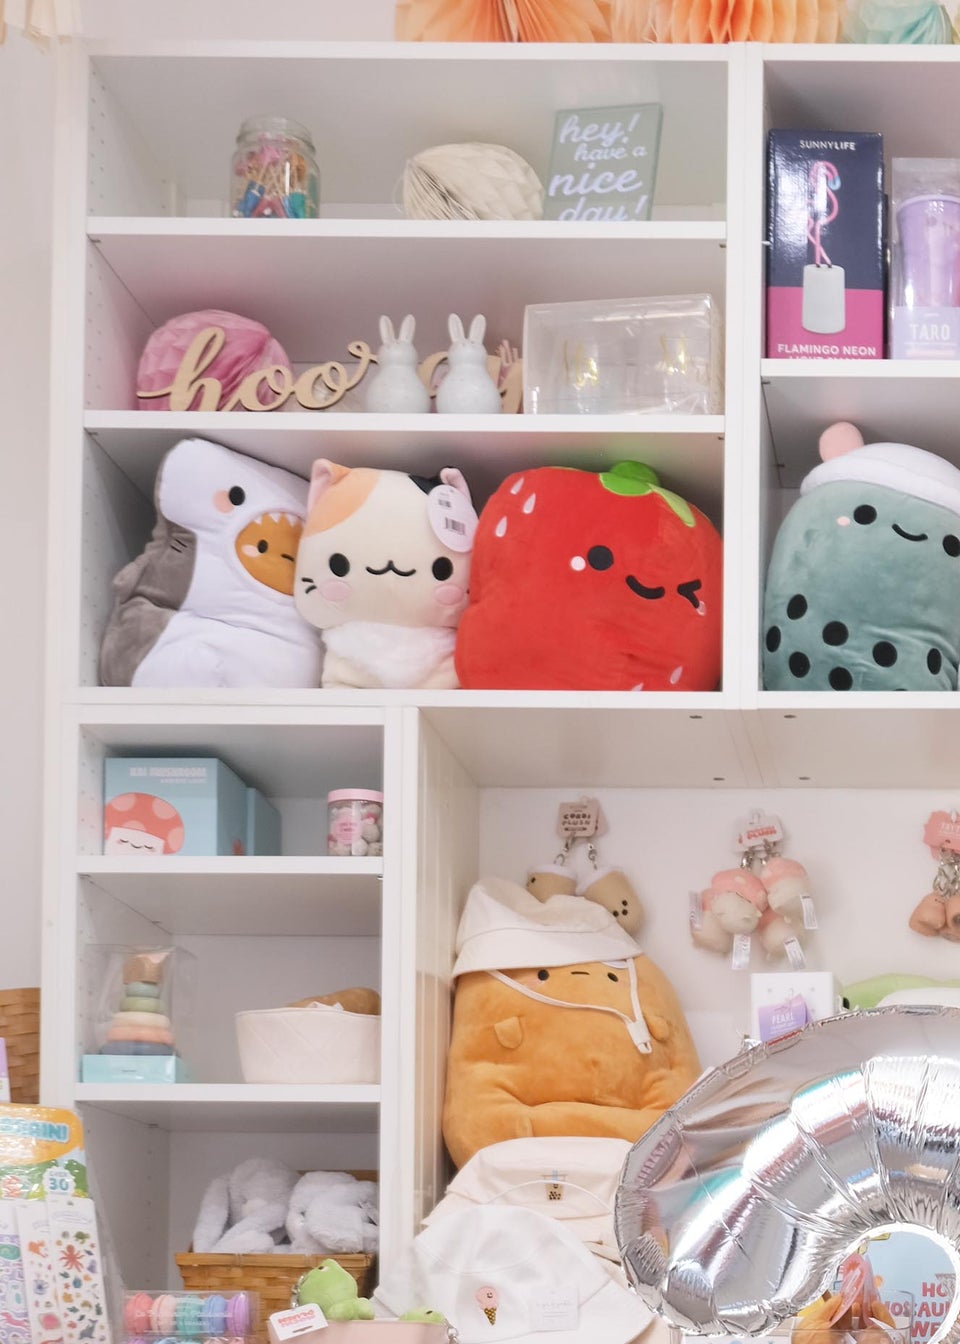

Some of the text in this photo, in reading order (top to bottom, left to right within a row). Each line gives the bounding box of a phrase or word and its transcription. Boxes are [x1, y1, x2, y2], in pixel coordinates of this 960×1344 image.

[560, 112, 641, 147] hey!
[574, 143, 647, 161] have a
[799, 139, 856, 151] SUNNYLIFE
[548, 162, 643, 197] nice
[909, 324, 950, 341] TARO
[777, 343, 840, 355] FLAMINGO
[842, 345, 877, 357] NEON
[49, 1178, 69, 1191] 30
